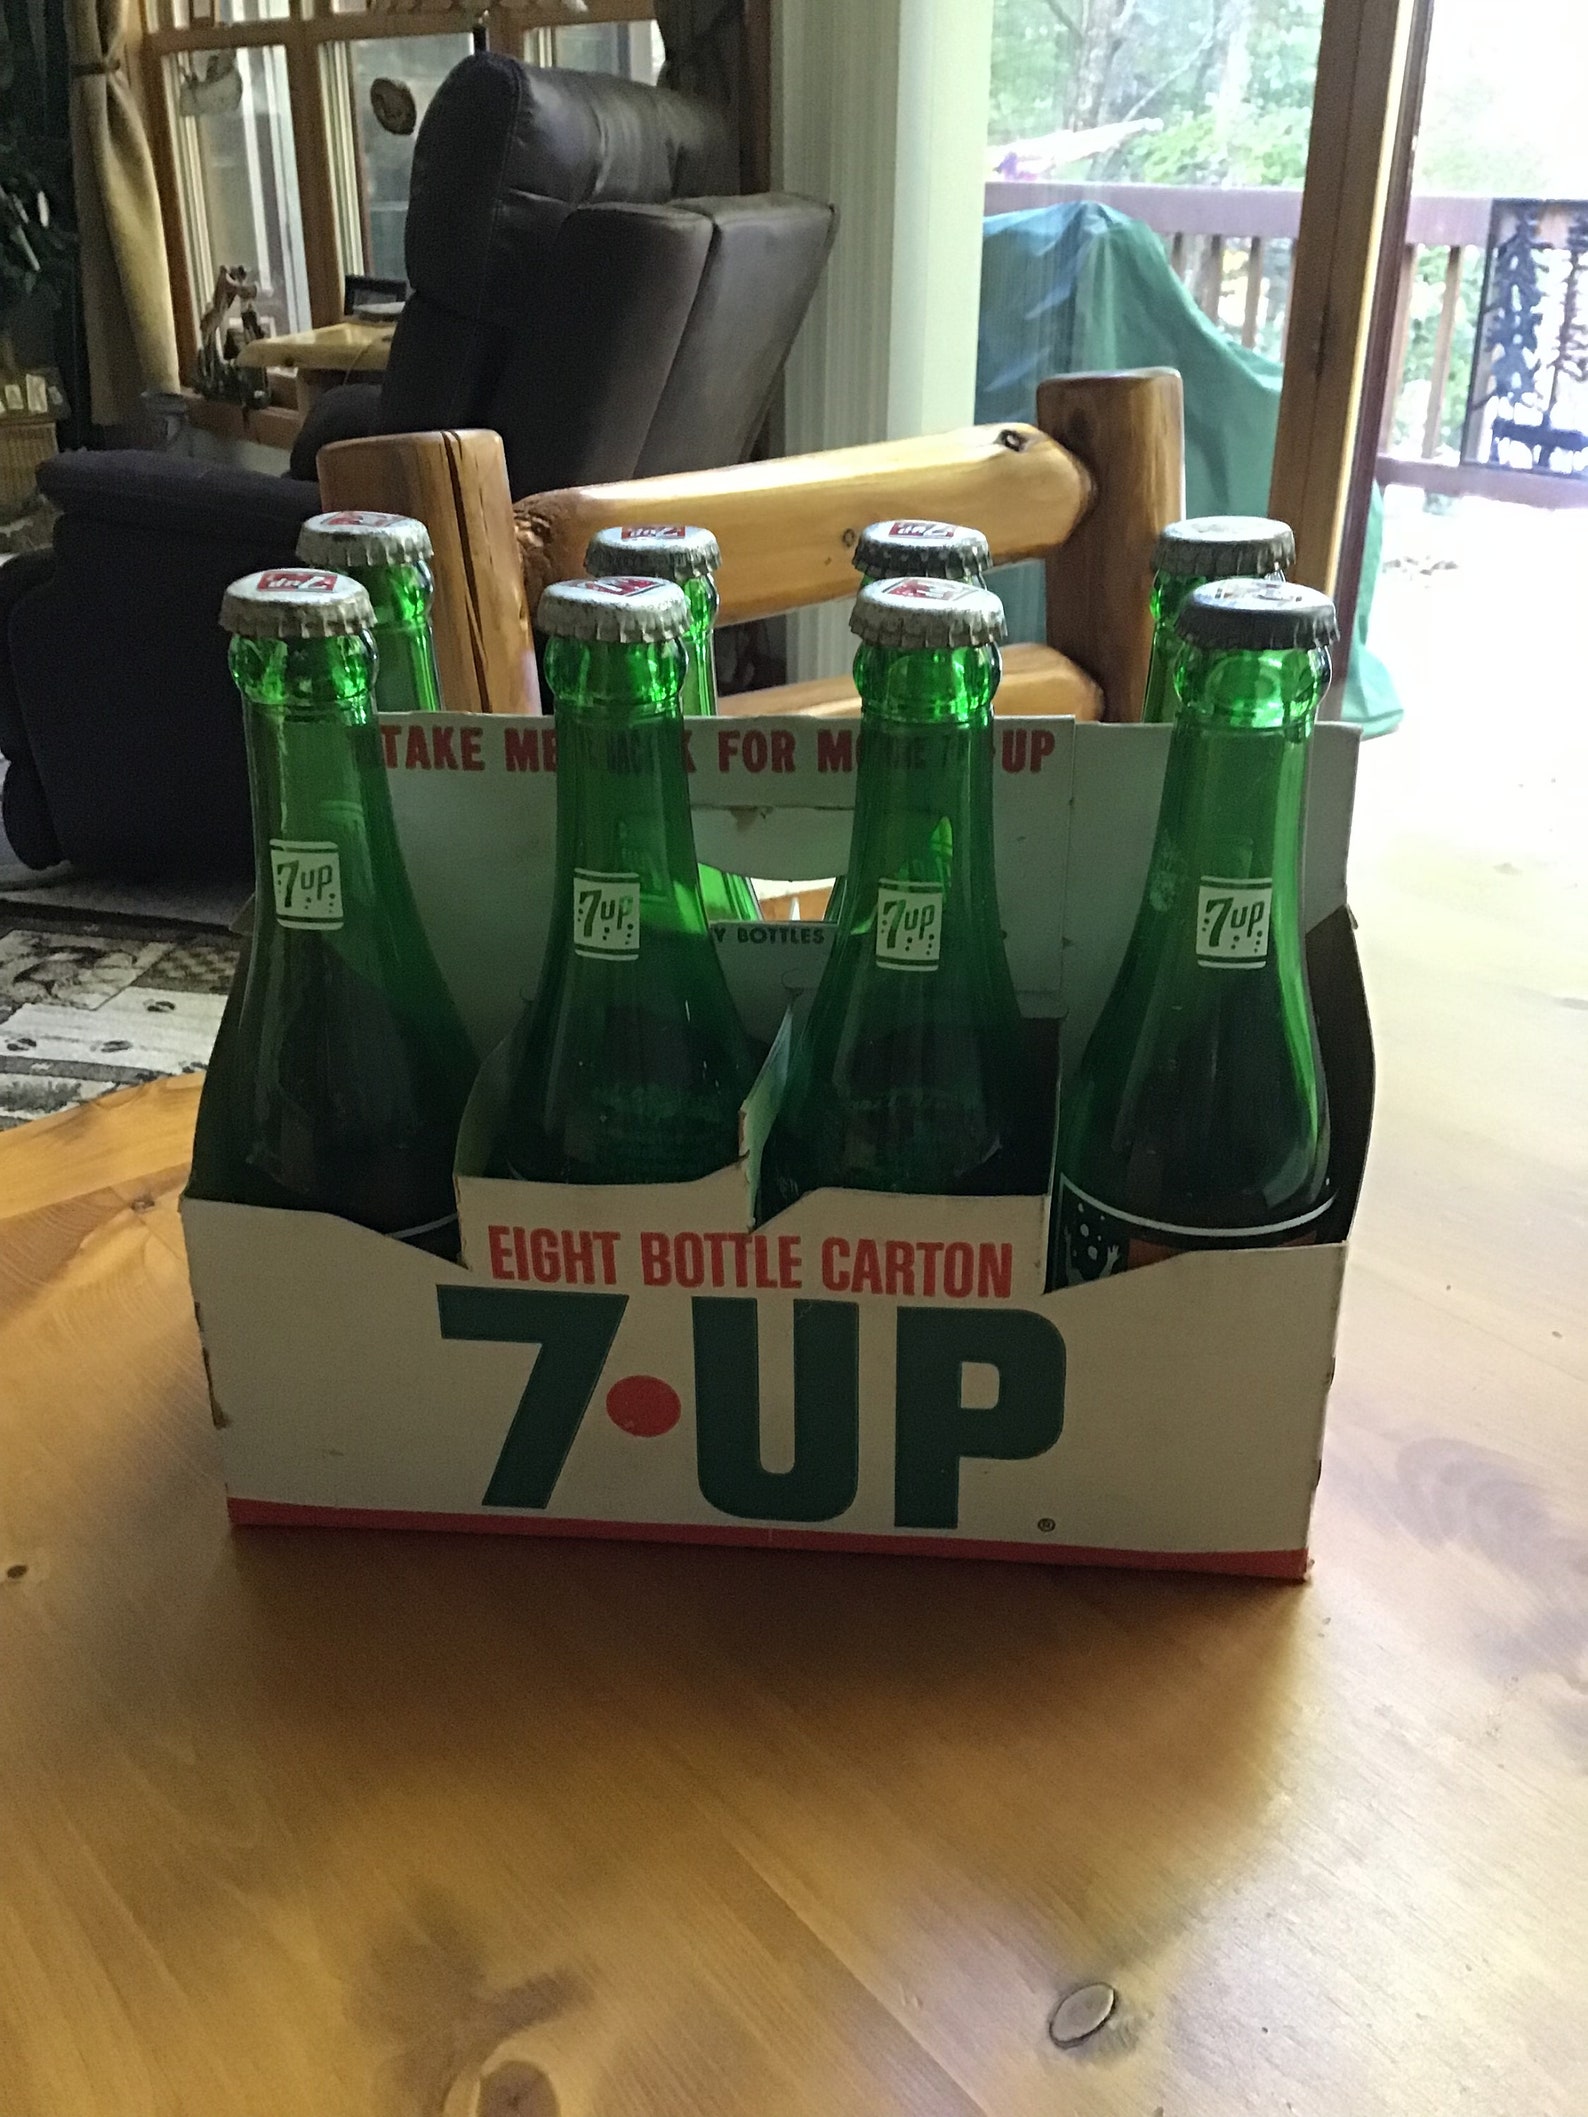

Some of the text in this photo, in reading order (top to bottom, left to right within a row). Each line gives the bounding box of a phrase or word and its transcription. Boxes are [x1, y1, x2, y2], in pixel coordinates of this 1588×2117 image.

[380, 725, 485, 771] TAKE
[718, 729, 796, 773] FOR
[738, 927, 825, 945] BOTTLES
[488, 1225, 1013, 1299] EIGHT BOTTLE CARTON
